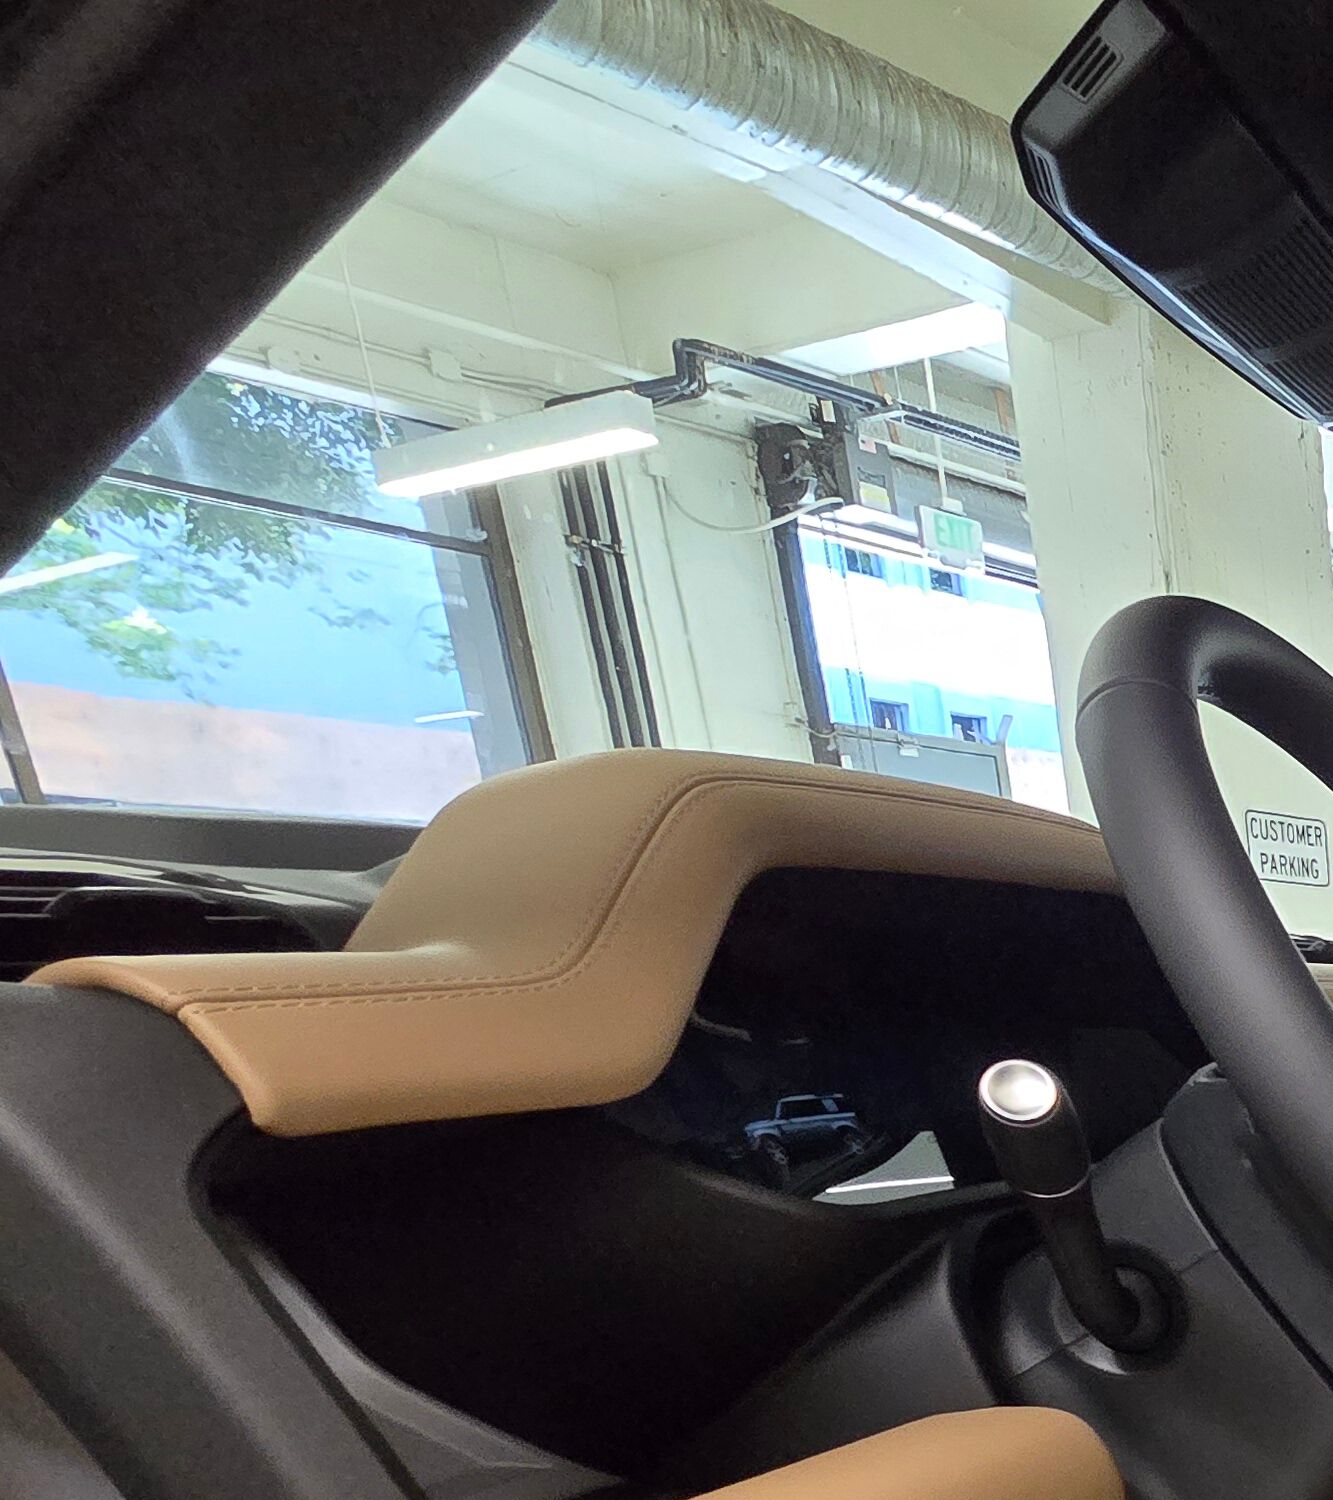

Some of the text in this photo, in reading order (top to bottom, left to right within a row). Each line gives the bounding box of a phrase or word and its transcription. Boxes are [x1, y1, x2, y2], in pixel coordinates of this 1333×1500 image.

[933, 512, 974, 554] EXIT
[1250, 817, 1323, 847] CUSTOMER
[1260, 852, 1319, 879] PARKING
